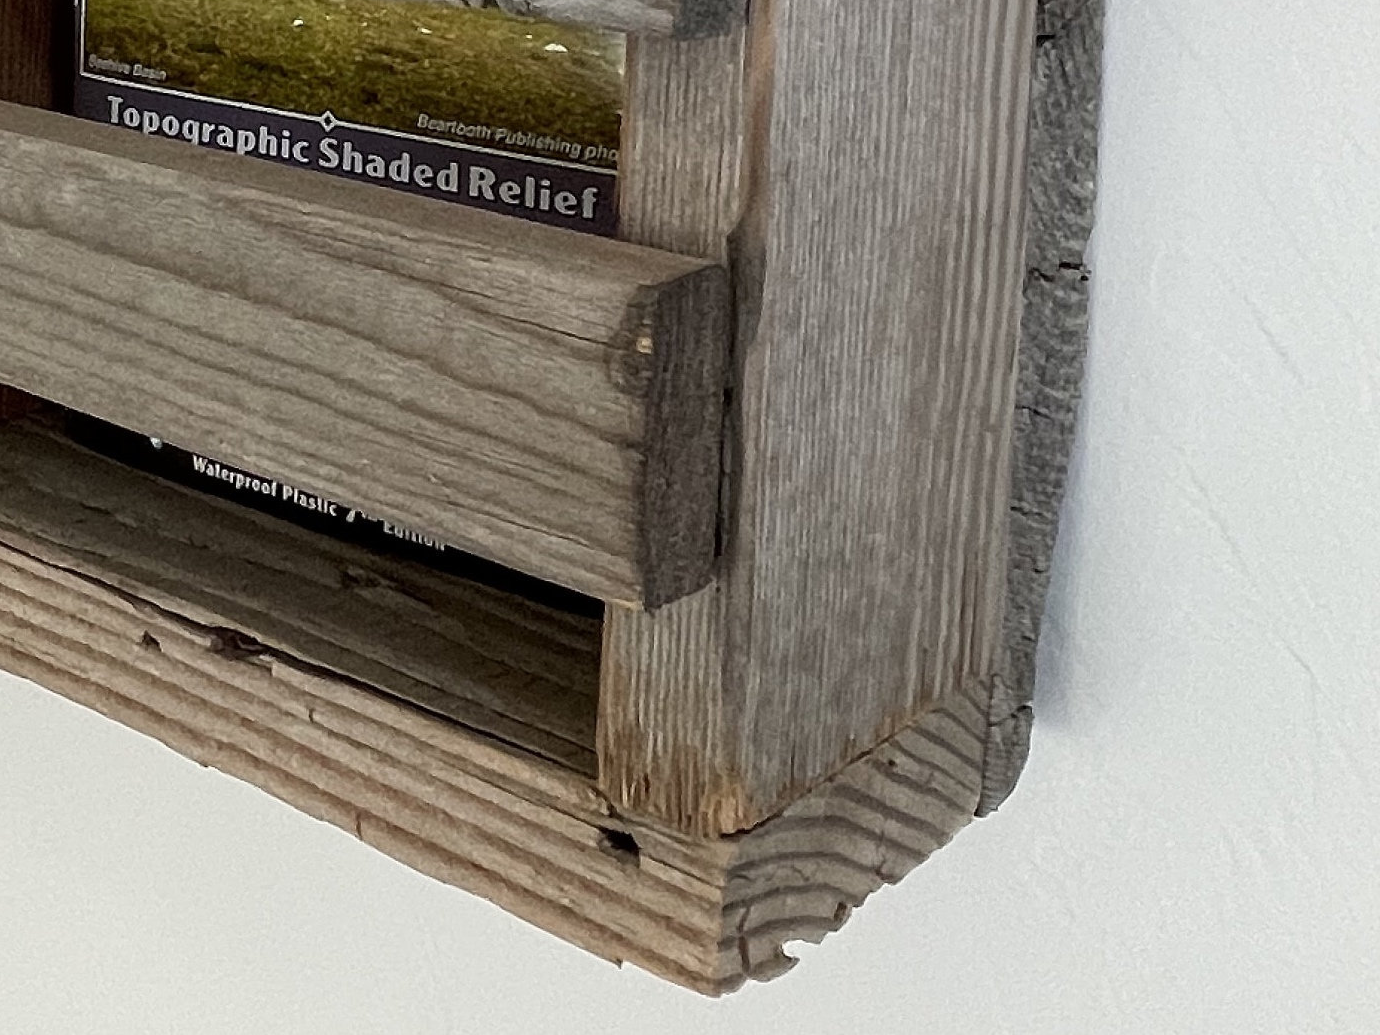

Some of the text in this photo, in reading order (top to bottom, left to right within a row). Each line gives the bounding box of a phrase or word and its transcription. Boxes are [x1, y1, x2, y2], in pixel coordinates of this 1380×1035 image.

[107, 95, 600, 219] Topographic Shaded Relief
[417, 113, 619, 163] Beartooth Publishing pho
[192, 454, 338, 517] Waterproof Plastic
